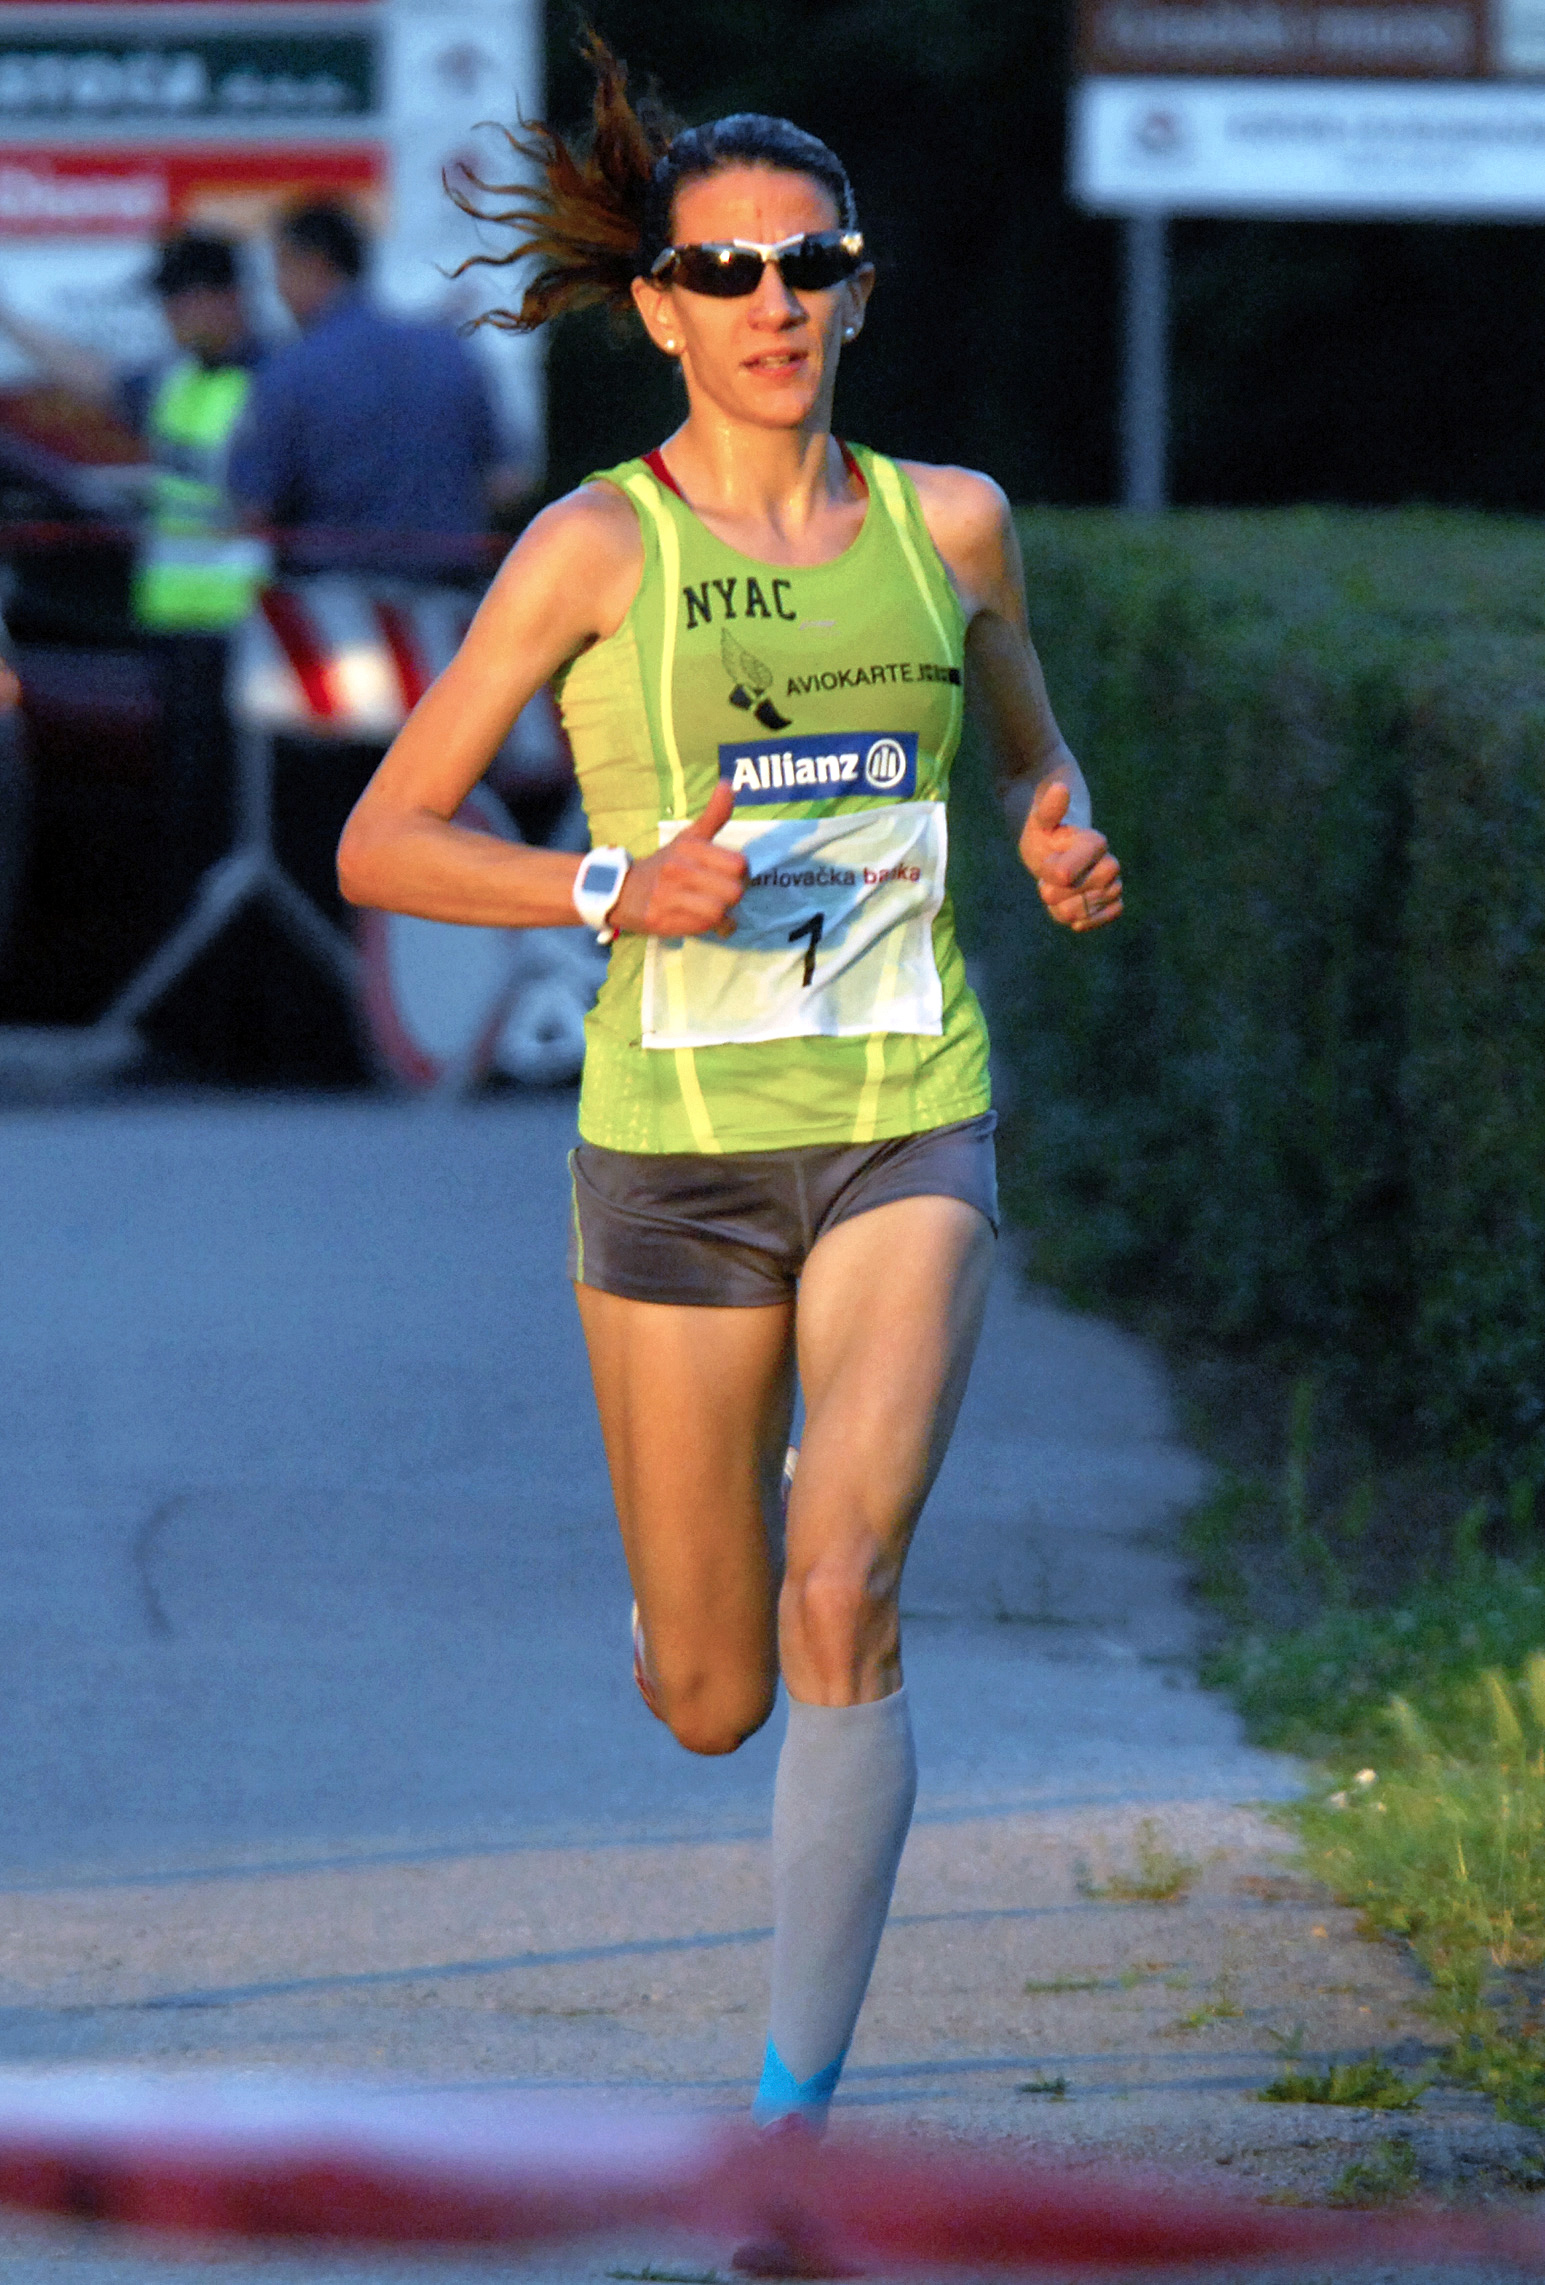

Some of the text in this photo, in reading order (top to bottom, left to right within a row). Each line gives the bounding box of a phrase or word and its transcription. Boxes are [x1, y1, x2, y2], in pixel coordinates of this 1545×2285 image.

[683, 577, 796, 629] NYAC
[732, 752, 859, 791] Allianz
[750, 866, 856, 888] arlovačka
